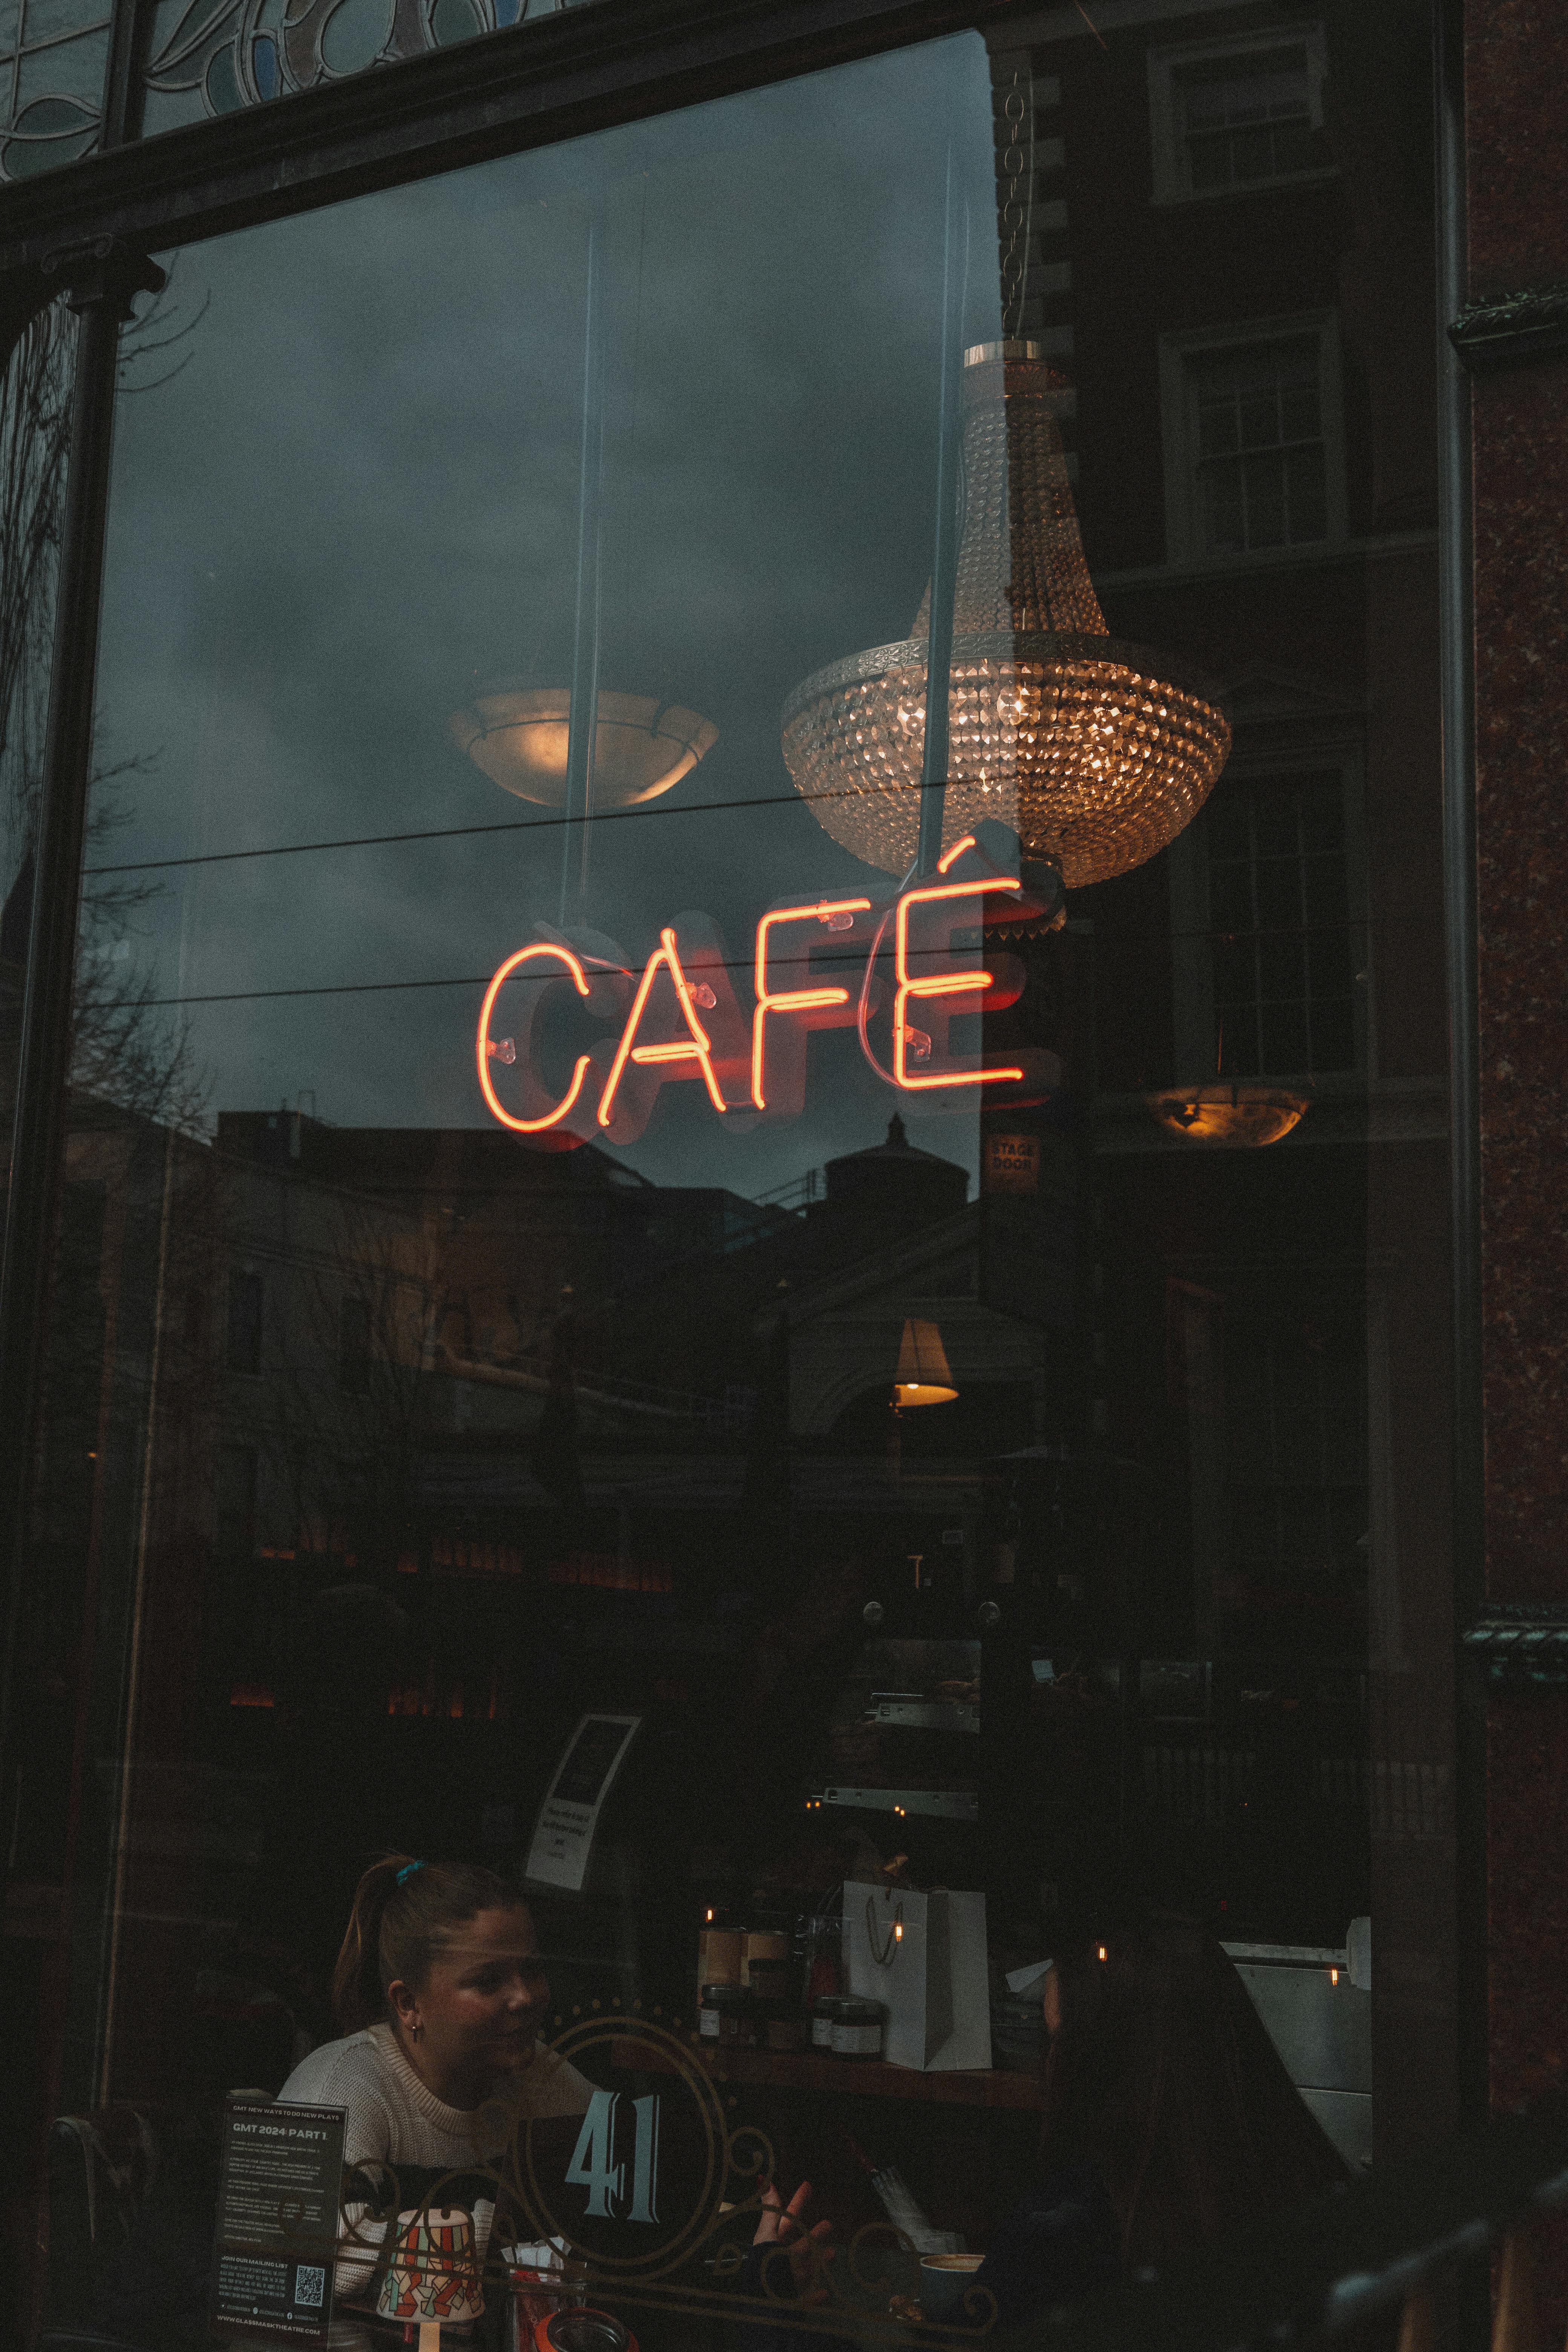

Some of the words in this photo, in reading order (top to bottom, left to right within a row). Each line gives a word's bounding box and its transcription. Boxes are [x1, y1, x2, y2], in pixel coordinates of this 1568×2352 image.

[476, 835, 1023, 1133] CAFÉ
[992, 1143, 1034, 1156] STAGE
[993, 1158, 1032, 1170] DOOR
[233, 2123, 258, 2133] GMT
[289, 2128, 320, 2140] PART
[565, 2091, 660, 2223] 41
[248, 2259, 274, 2267] MAILING
[217, 2315, 320, 2335] WWW.GLASSMASKTHEATRE.COM
